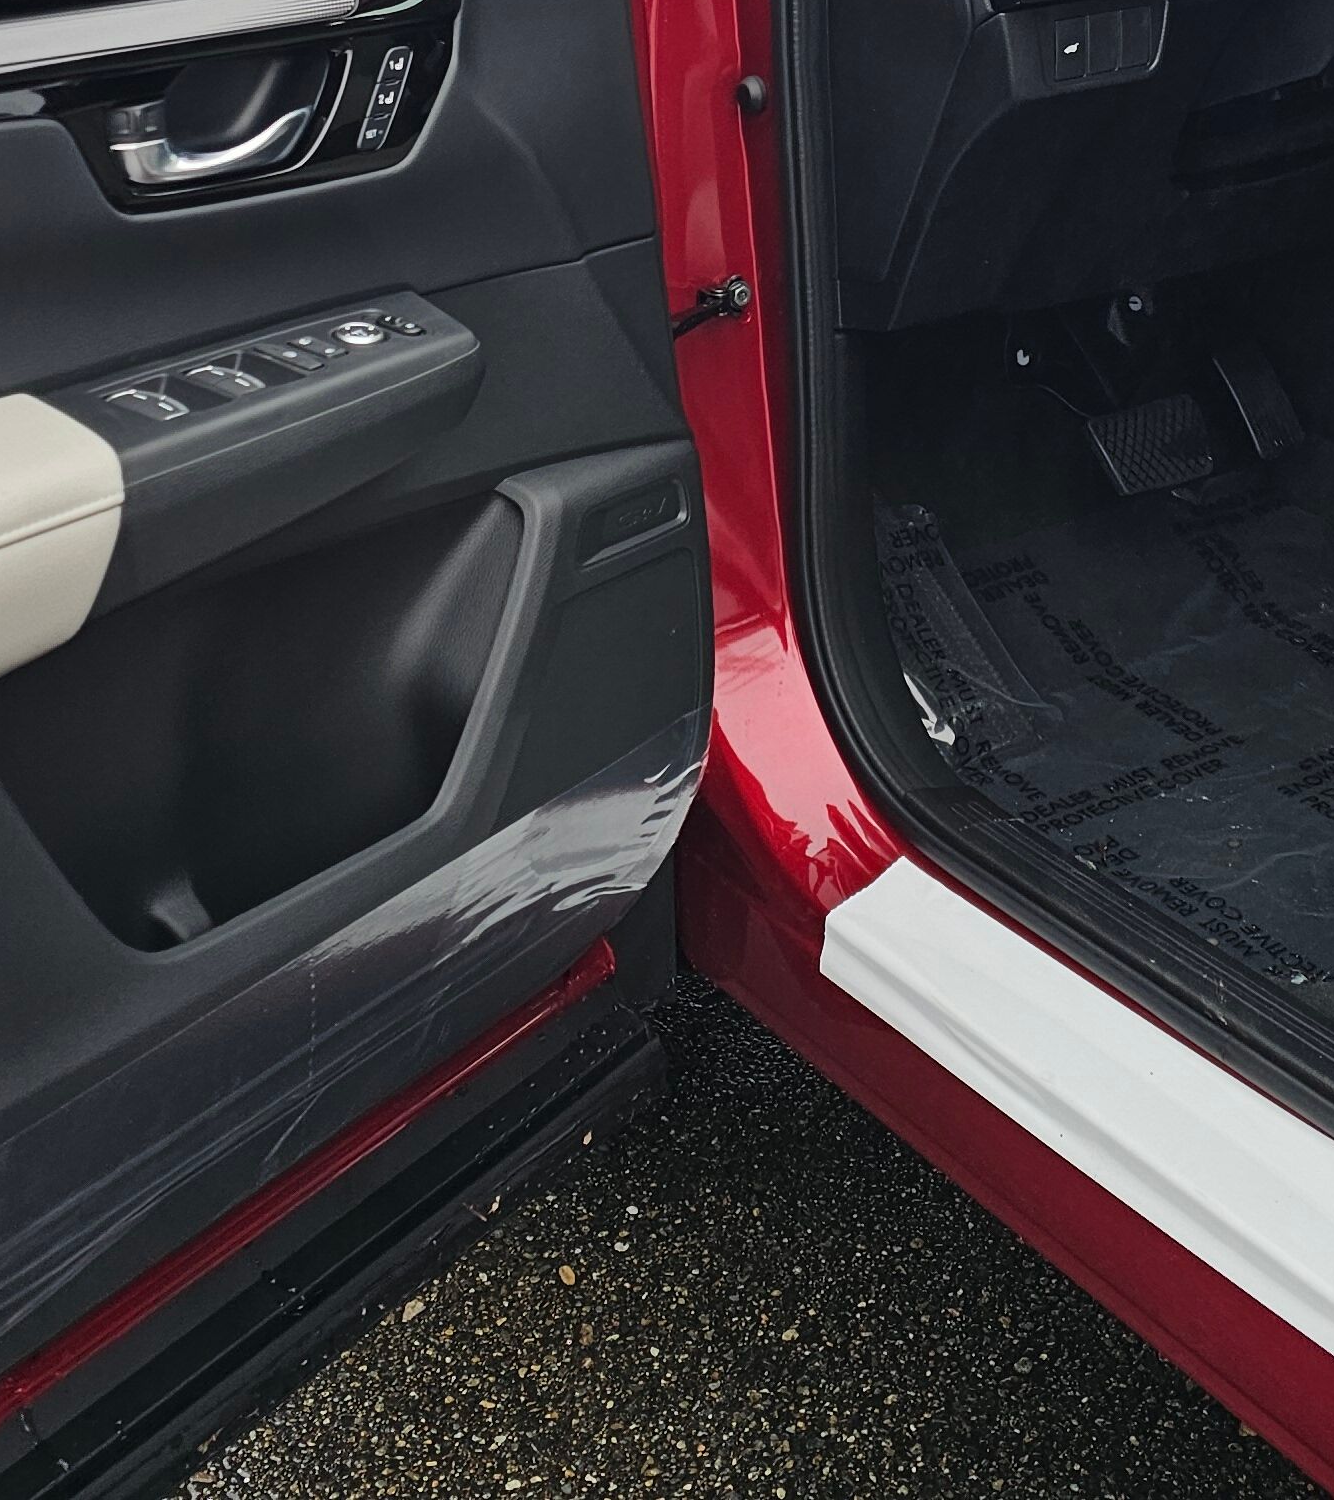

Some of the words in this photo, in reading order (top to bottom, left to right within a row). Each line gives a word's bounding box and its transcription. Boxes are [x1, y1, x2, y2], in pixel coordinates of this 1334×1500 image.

[1019, 788, 1099, 823] DEALER
[1101, 765, 1156, 794] MUST
[1160, 734, 1252, 771] REMOVE
[1035, 783, 1161, 835] PROTECTIVE
[1156, 757, 1231, 791] COVER
[1110, 868, 1200, 918] REMOVE
[1168, 876, 1244, 922] COVER
[1198, 917, 1261, 958] MUST
